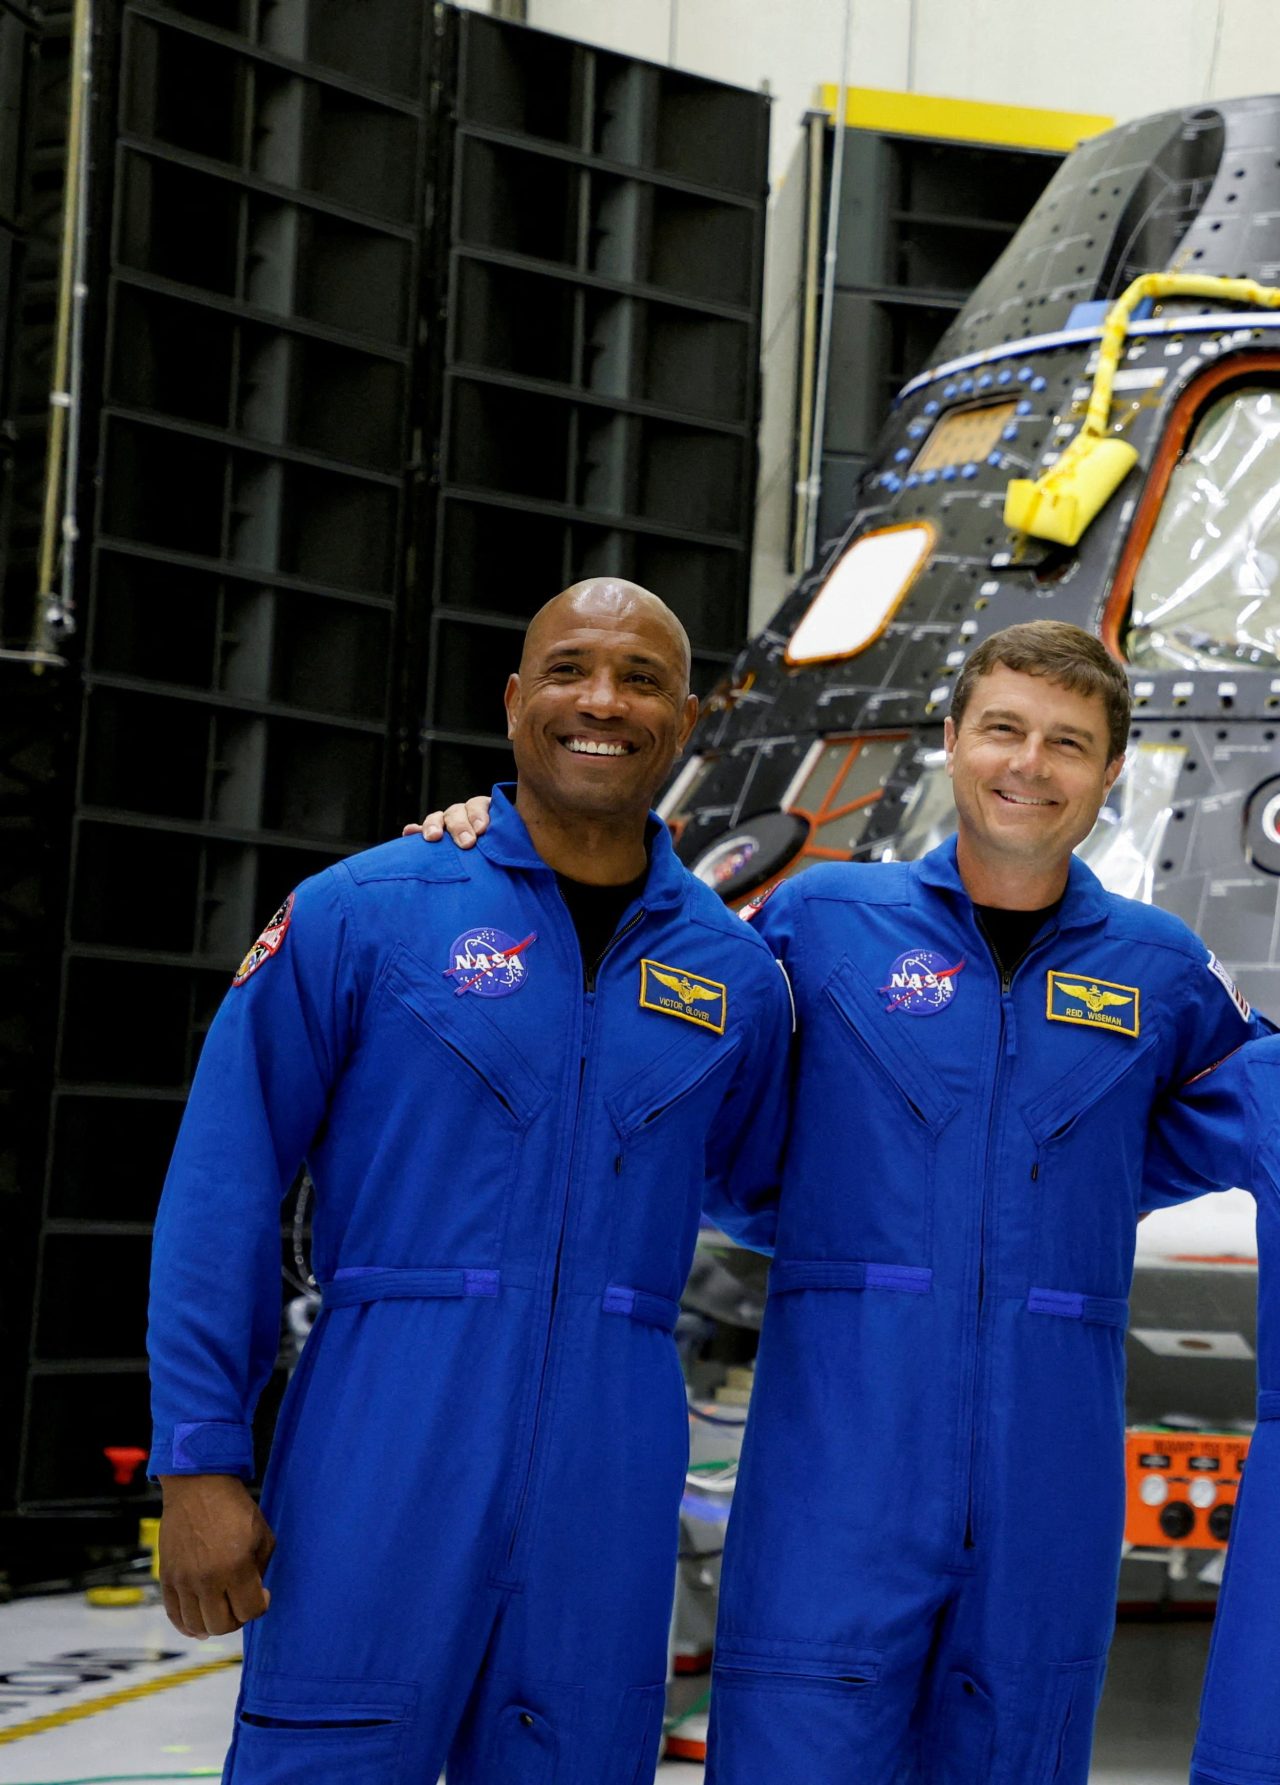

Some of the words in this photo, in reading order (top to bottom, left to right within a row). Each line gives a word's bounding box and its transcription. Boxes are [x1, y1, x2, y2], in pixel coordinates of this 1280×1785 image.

[455, 953, 524, 971] NASA
[890, 973, 954, 992] NASA
[659, 996, 684, 1012] VICTOR
[685, 1005, 710, 1022] GLOVER
[1065, 1007, 1083, 1018] REID
[1087, 1011, 1122, 1026] WISEMAN
